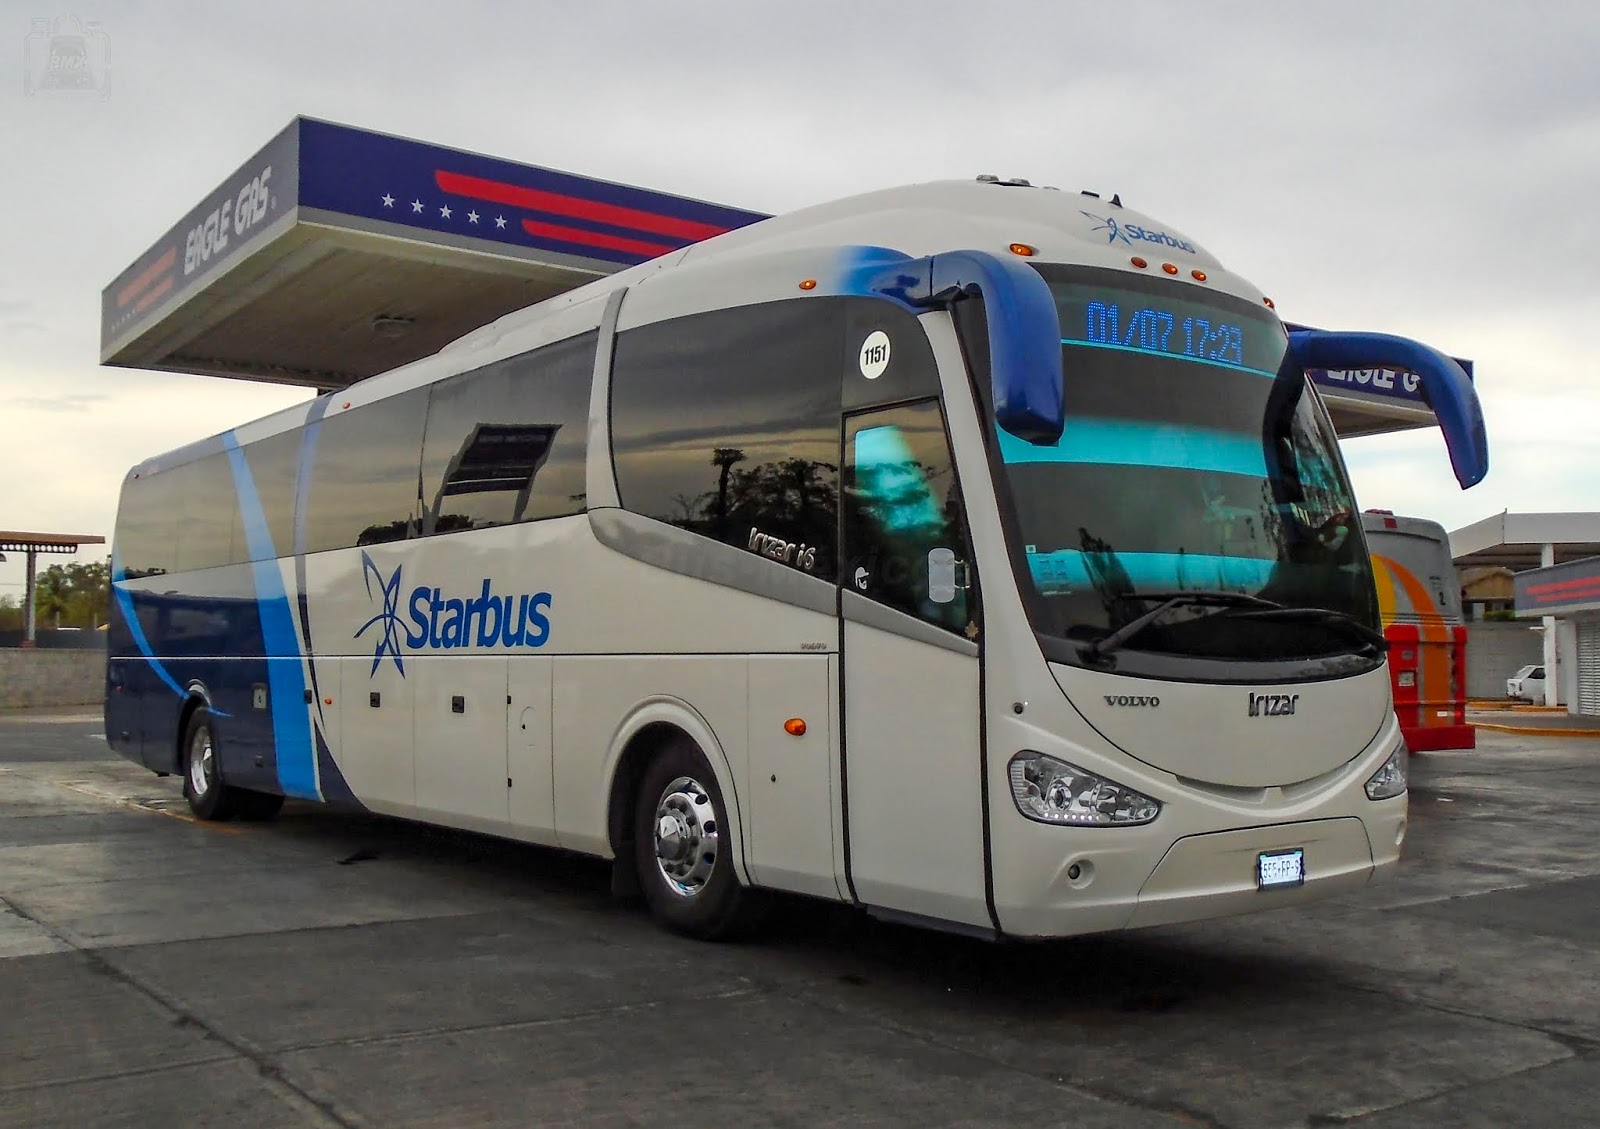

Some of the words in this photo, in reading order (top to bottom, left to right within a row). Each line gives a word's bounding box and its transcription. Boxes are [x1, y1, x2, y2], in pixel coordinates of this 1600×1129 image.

[184, 198, 231, 275] EAGLE
[234, 165, 272, 236] GAS
[1124, 223, 1196, 254] Starbus
[1087, 301, 1174, 351] 01/07
[864, 344, 887, 366] 1151
[748, 527, 796, 562] Irizar
[796, 543, 816, 570] i6
[406, 578, 552, 649] Starbus
[1104, 695, 1160, 707] VOLVO
[1248, 691, 1299, 717] Irizar
